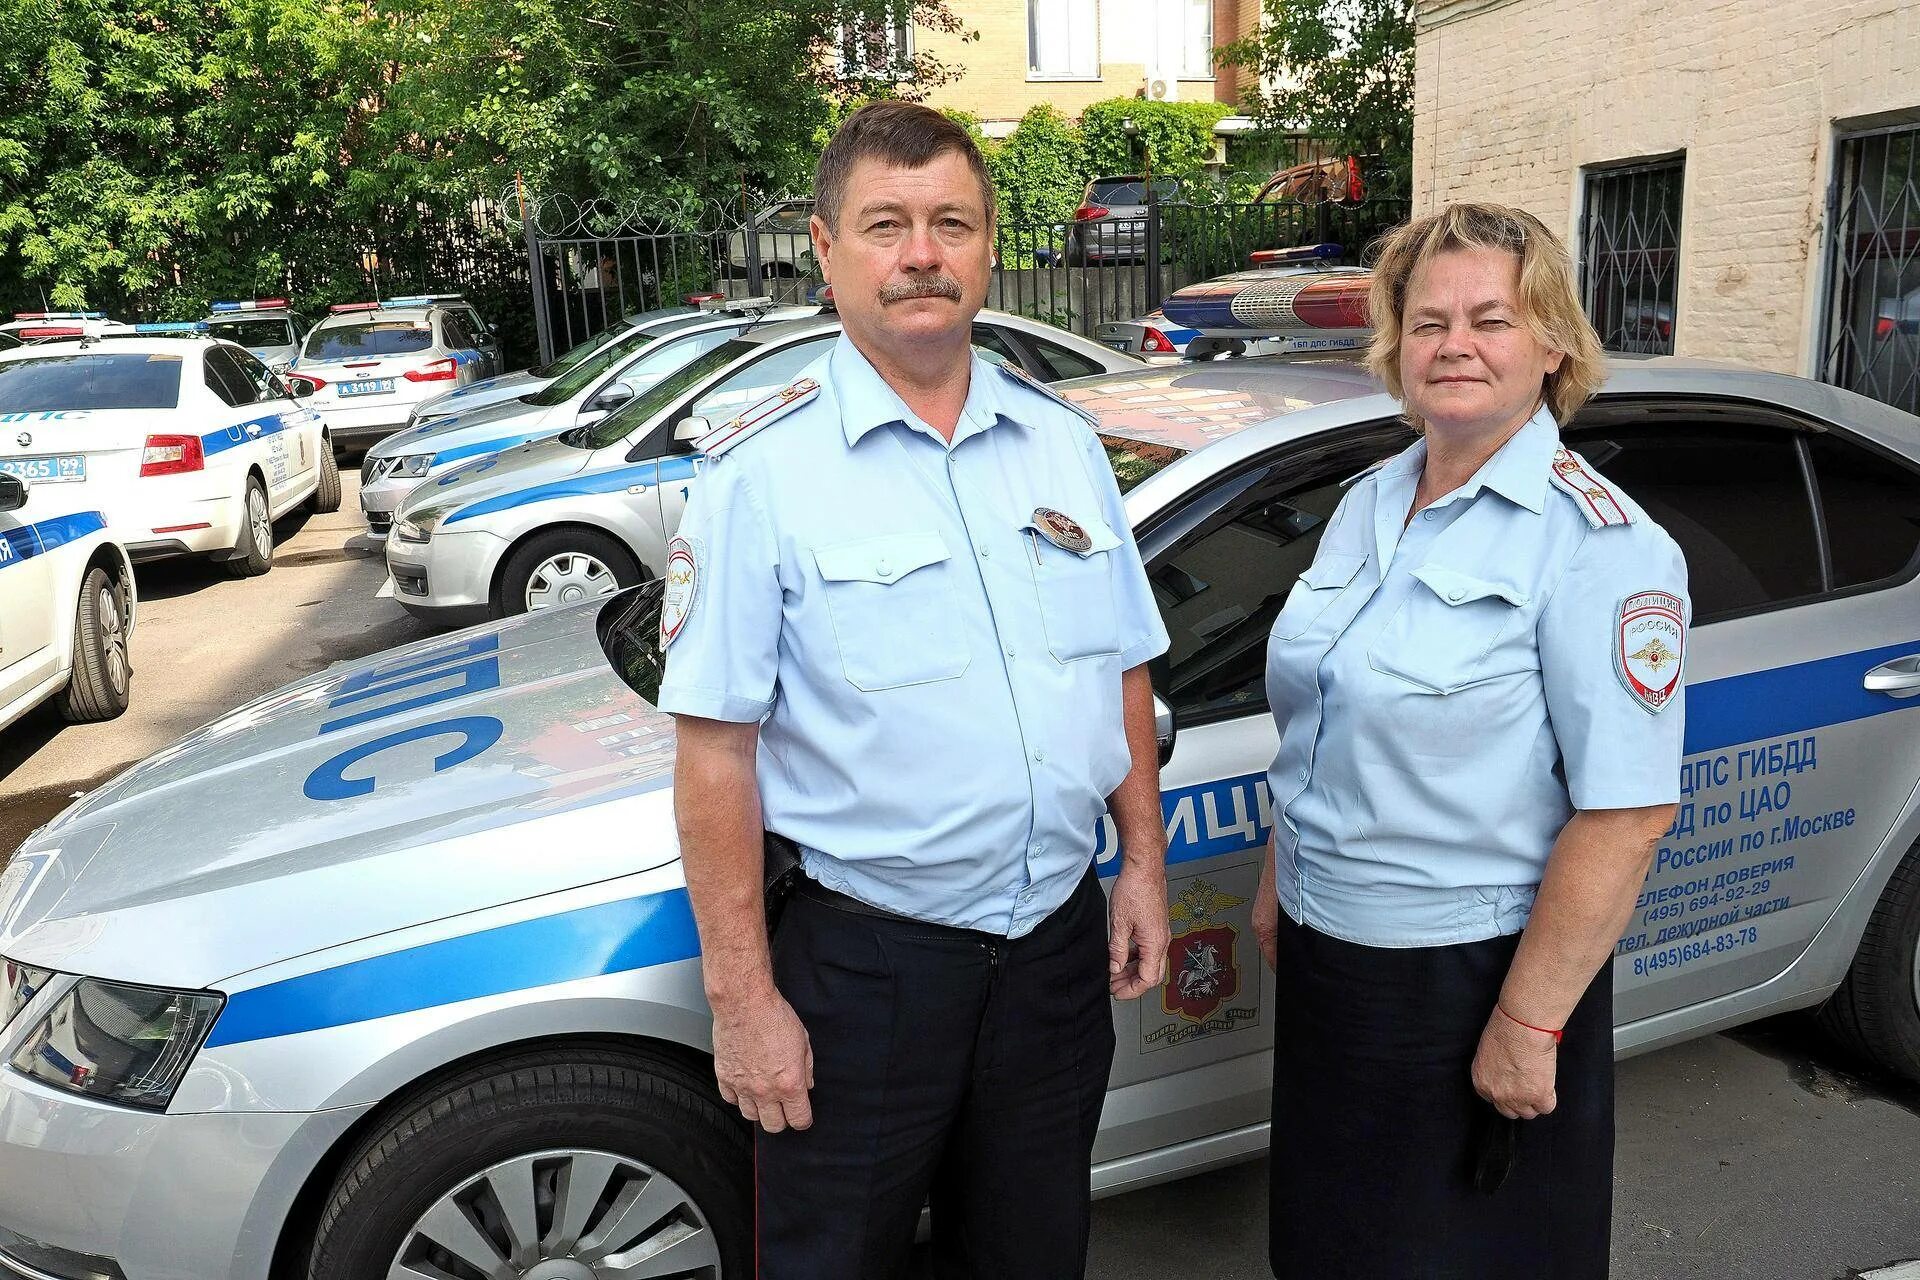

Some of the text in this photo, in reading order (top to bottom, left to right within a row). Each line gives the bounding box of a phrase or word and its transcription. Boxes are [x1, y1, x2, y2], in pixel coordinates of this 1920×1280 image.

[1310, 340, 1327, 348] ДПС
[1329, 338, 1356, 347] ГИБДД
[1630, 620, 1679, 640] РОССИЯ
[1680, 736, 1817, 797] ДПС ГИБДД
[1703, 802, 1732, 828] по
[1739, 781, 1791, 822] ЦАО
[1656, 806, 1857, 874] России по г.Москве
[1635, 855, 1795, 910] ЕЛЕФОН ДОВЕРИЯ
[1643, 879, 1771, 927] (495) 694-92-29
[1617, 896, 1791, 954] тел. дежурной части
[1633, 926, 1758, 977] 8(495)684-83-78
